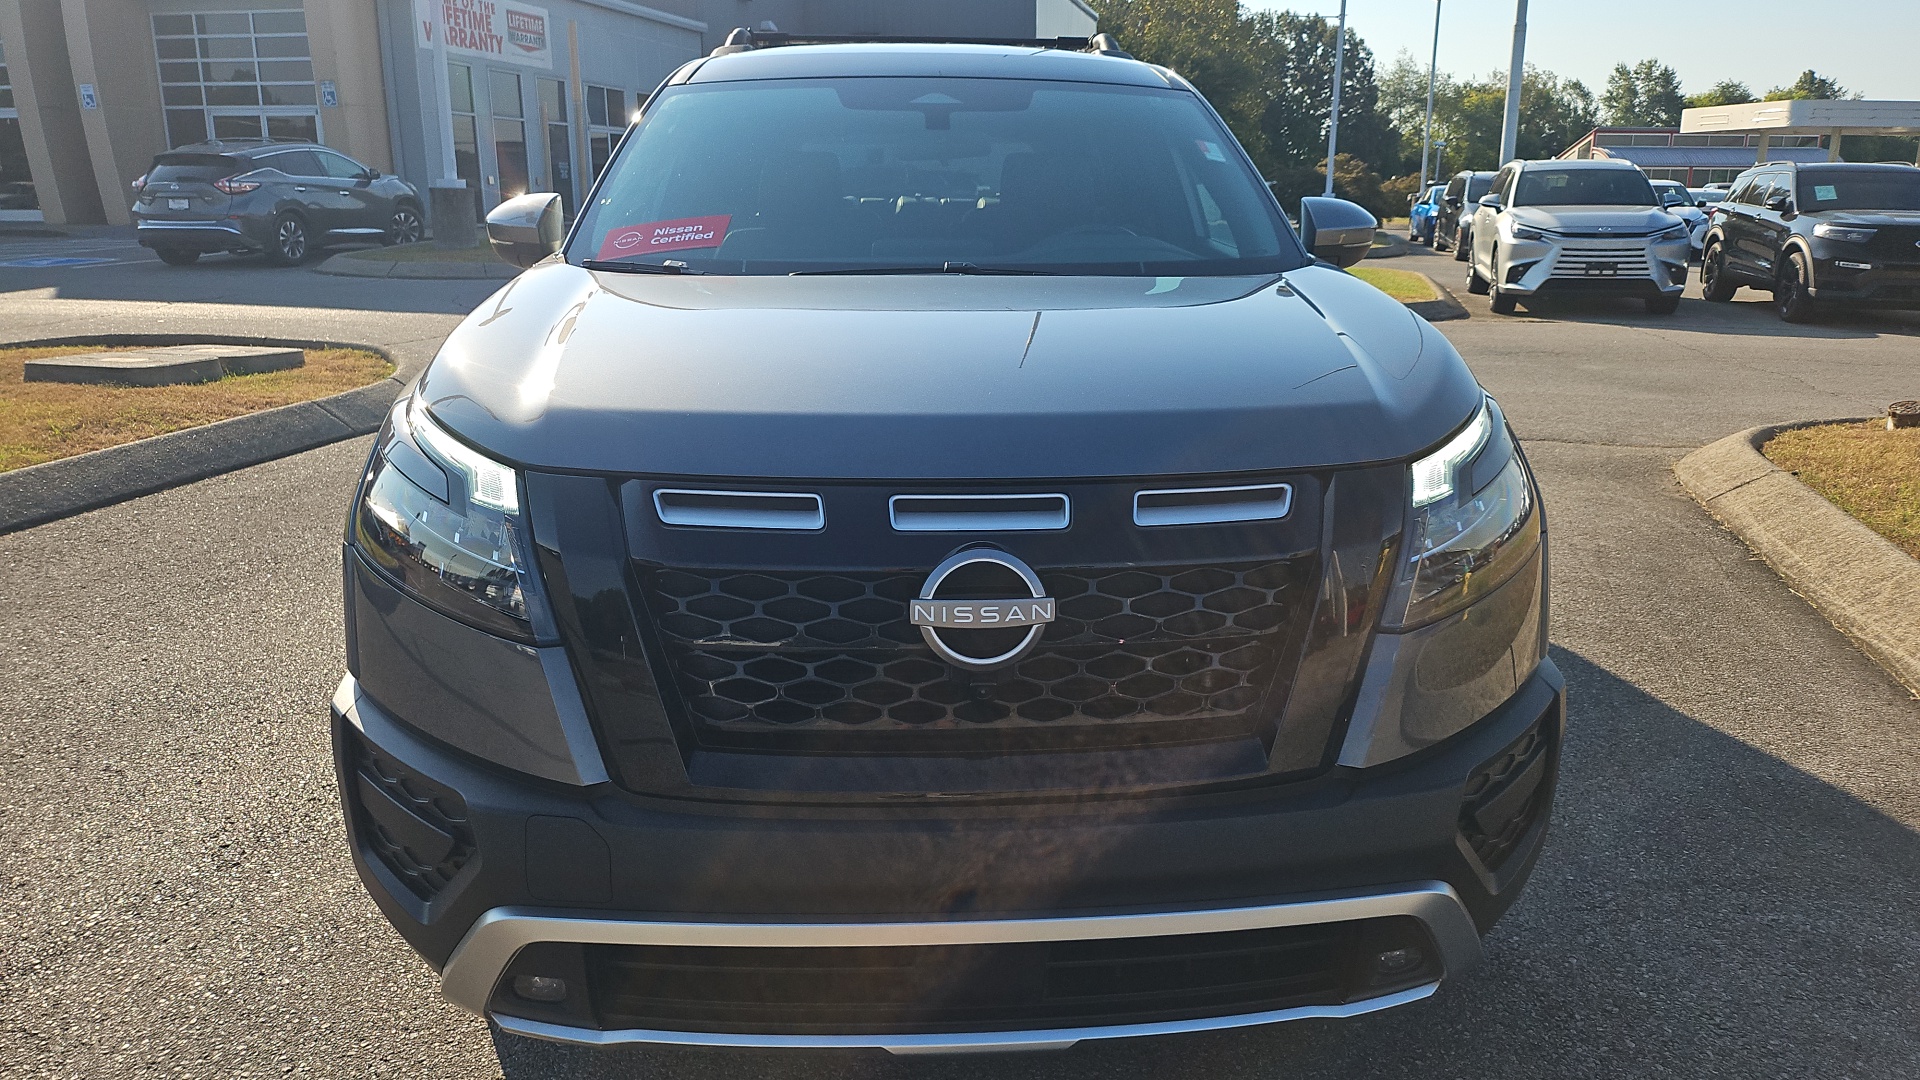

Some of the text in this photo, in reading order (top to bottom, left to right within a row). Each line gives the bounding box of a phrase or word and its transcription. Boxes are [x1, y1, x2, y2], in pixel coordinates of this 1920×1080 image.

[478, 0, 495, 15] THE
[442, 3, 492, 33] IFETIME
[508, 13, 544, 34] LIFETIME
[650, 231, 713, 245] Certified
[654, 225, 702, 236] Nissan
[914, 603, 1051, 623] NISSAN
